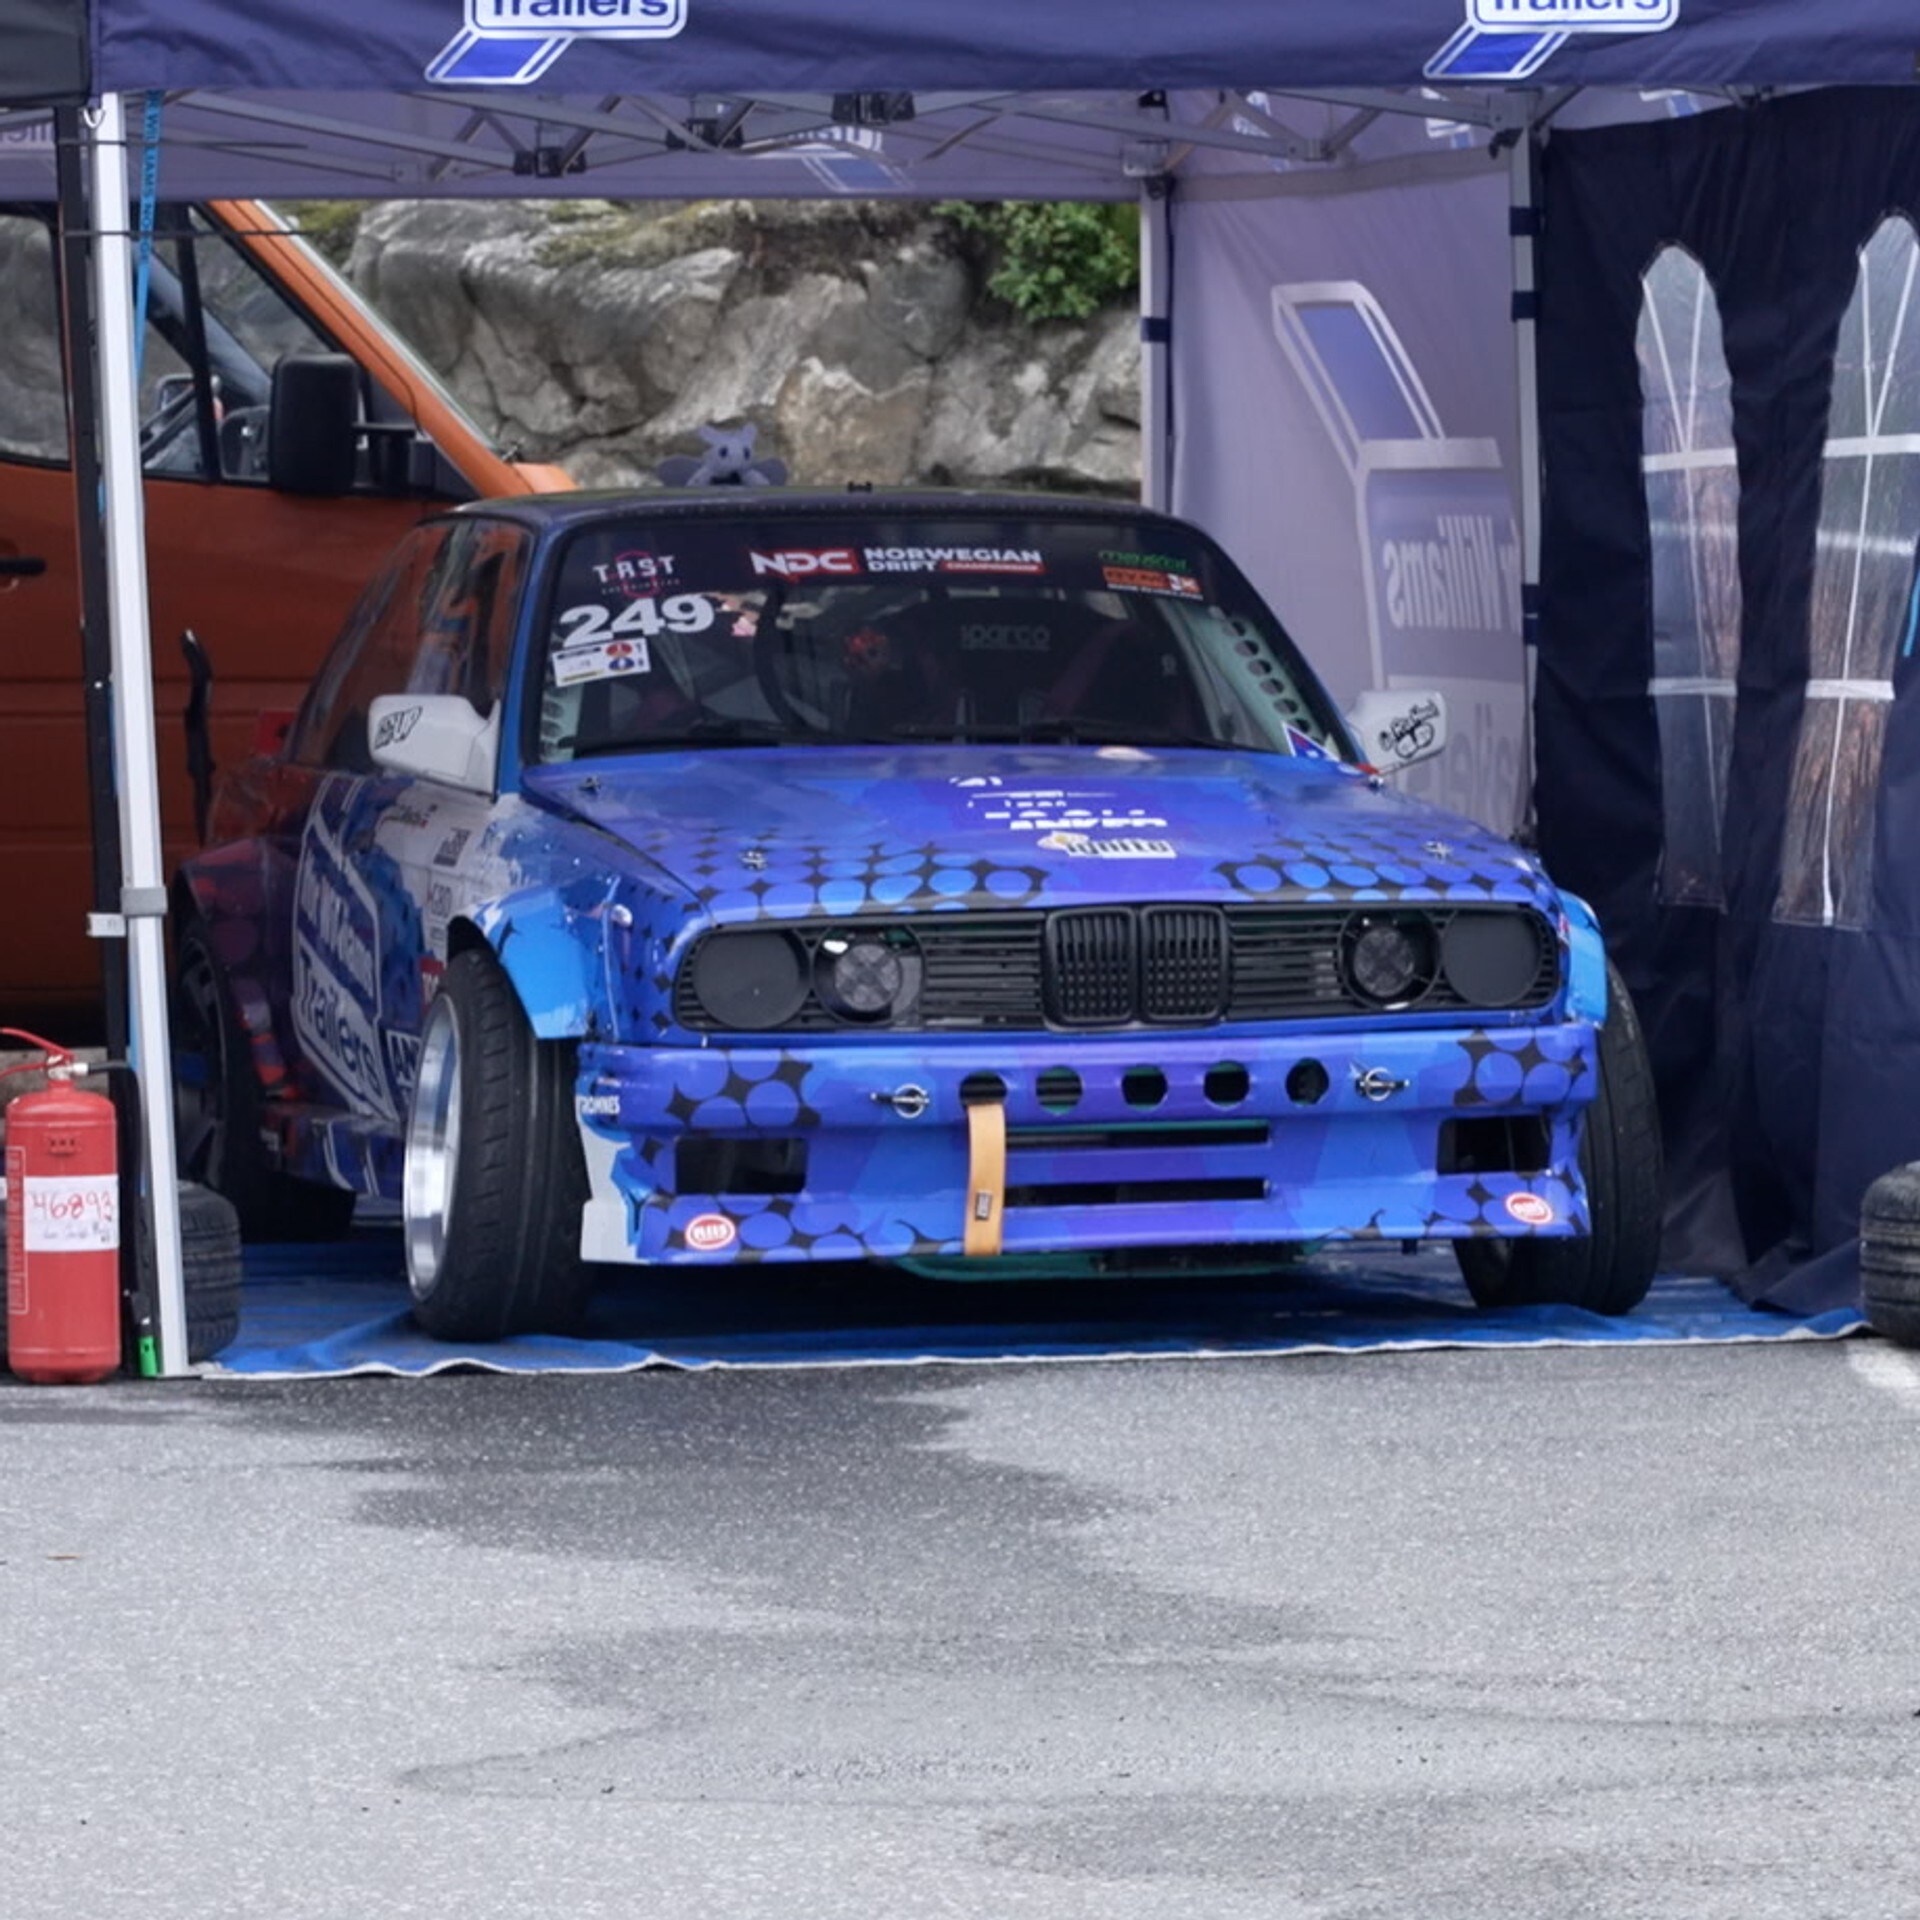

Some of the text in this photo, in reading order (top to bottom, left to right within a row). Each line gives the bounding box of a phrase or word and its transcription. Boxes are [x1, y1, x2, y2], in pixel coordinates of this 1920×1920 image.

[750, 548, 1042, 575] NDC NORWEGIAN
[867, 560, 937, 572] DRIFT
[559, 593, 714, 648] 249
